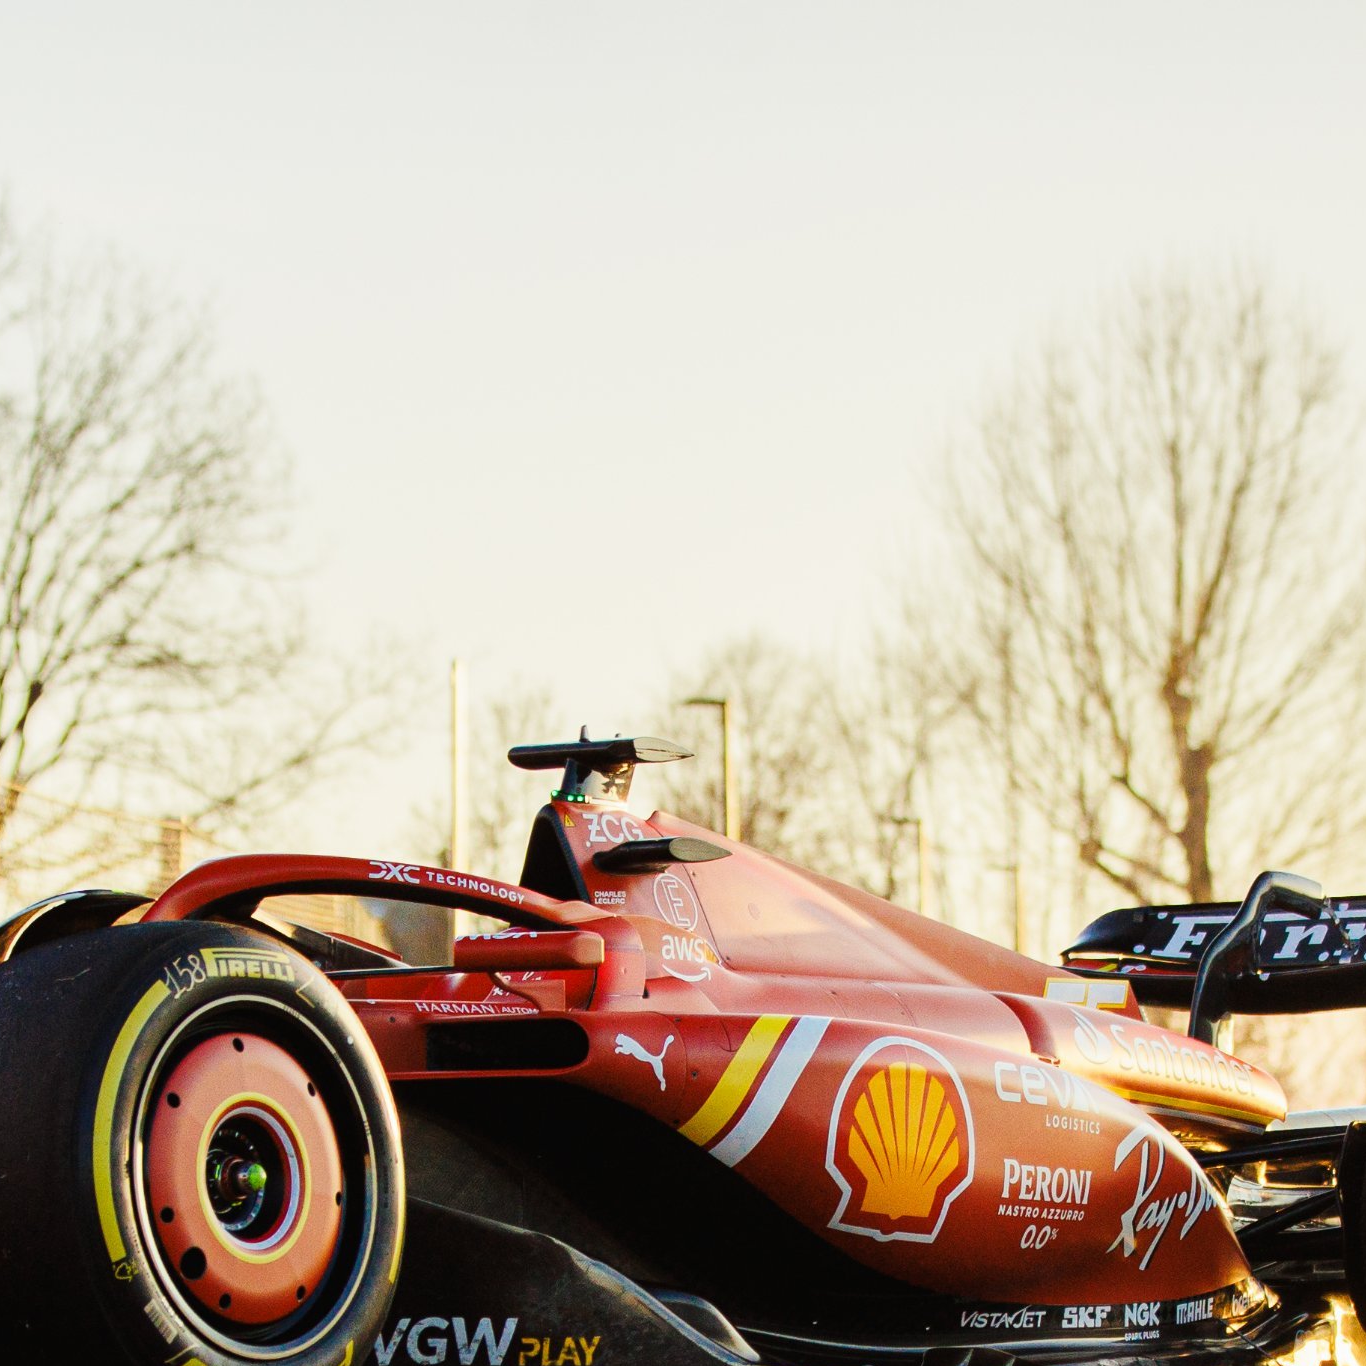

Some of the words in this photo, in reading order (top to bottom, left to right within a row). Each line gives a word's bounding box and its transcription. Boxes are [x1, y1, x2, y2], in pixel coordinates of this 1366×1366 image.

[369, 861, 420, 884] DXC
[426, 871, 525, 904] TECHNOLOGY
[594, 890, 626, 898] CHARLES
[661, 934, 705, 963] aws
[164, 954, 206, 999] 158
[199, 947, 295, 982] PIRELLI
[414, 1002, 497, 1015] HARMAN
[1109, 1023, 1256, 1097] Santander
[1045, 1114, 1100, 1134] LOGISTICS
[1001, 1158, 1092, 1205] PERONI
[998, 1205, 1039, 1218] NASTRO
[1041, 1208, 1085, 1221] AZZURRO
[1062, 1306, 1111, 1329] SKF
[1124, 1302, 1161, 1328] NGK
[1176, 1297, 1214, 1325] MAHLE
[373, 1317, 518, 1366] VGW
[518, 1336, 602, 1366] PLAY
[1143, 1330, 1160, 1339] PLUGS
